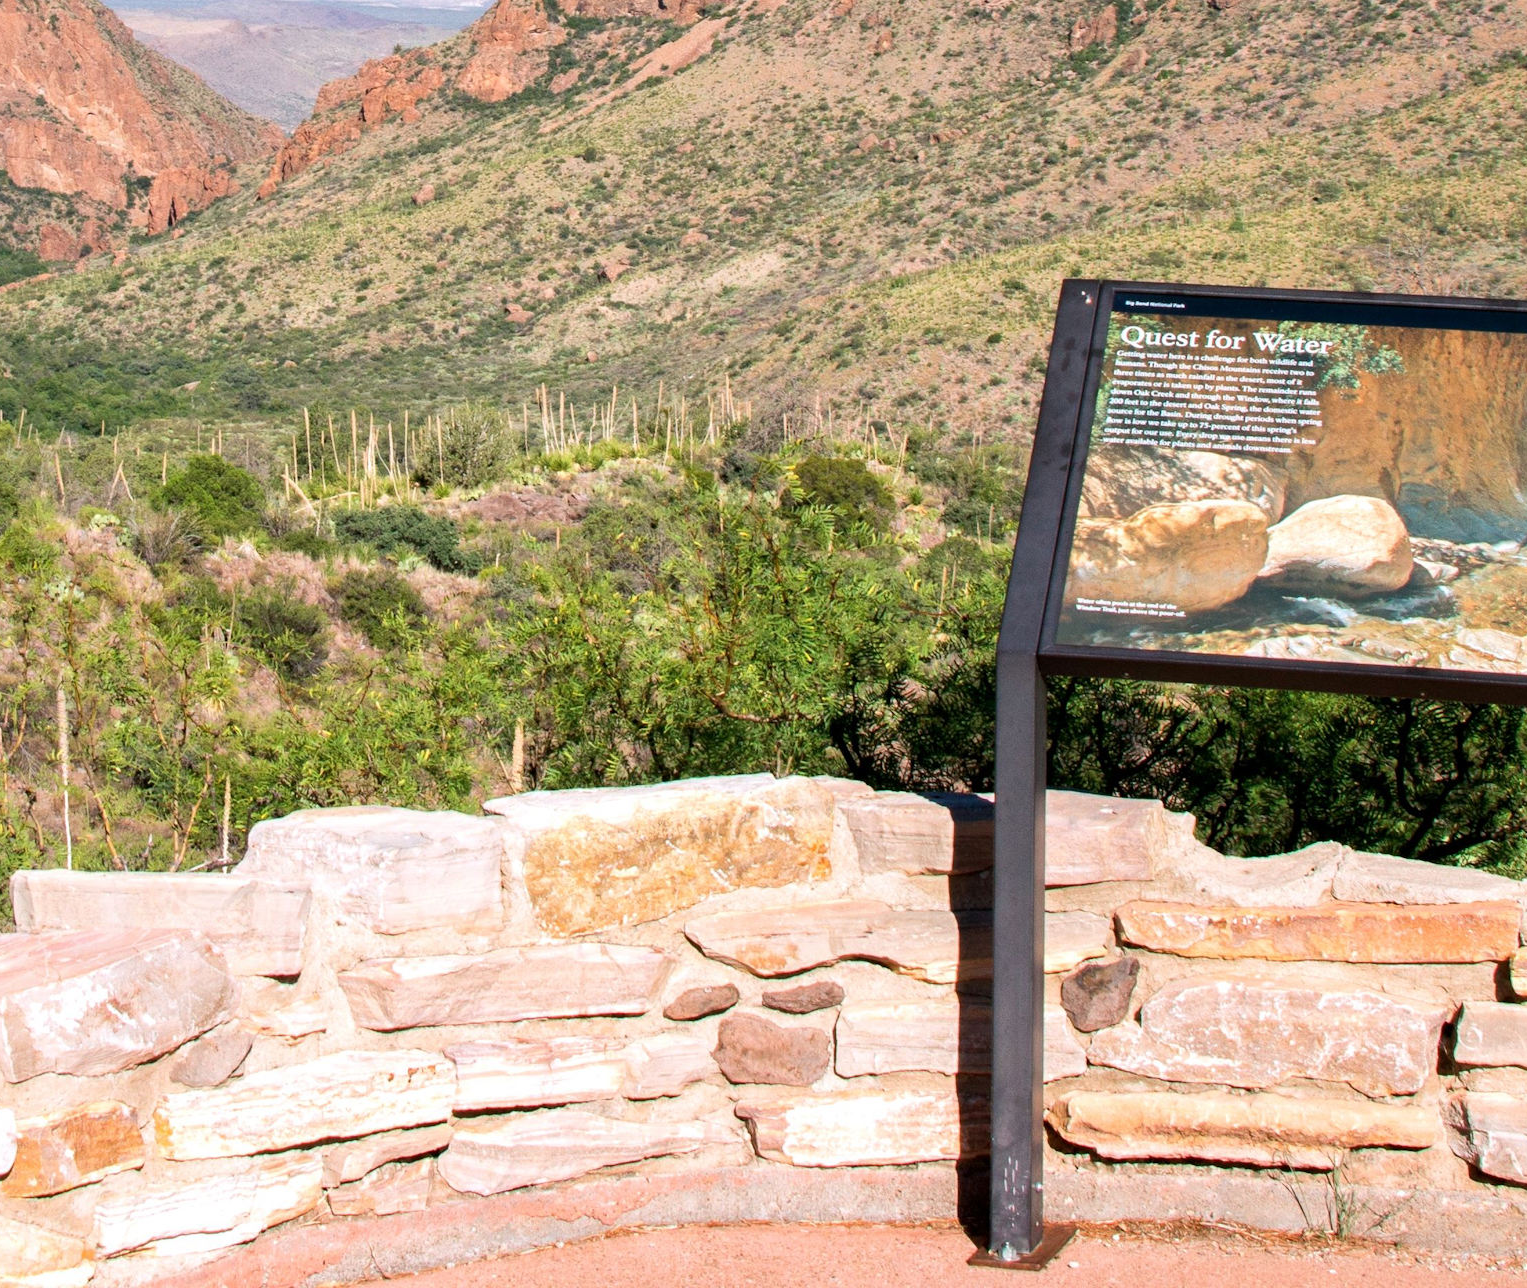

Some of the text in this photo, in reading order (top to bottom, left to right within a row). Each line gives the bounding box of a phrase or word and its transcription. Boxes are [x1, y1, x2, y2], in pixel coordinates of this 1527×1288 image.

[1121, 326, 1333, 354] Quest for Water
[1117, 351, 1145, 359] Getting
[1201, 355, 1235, 364] challenge
[1148, 362, 1178, 370] Though
[1112, 380, 1152, 388] evaporates
[1215, 384, 1239, 393] plants.
[1191, 393, 1221, 402] through
[1222, 405, 1248, 413] Spring,
[1185, 412, 1212, 420] During
[1214, 414, 1243, 422] drought
[1245, 416, 1274, 424] periods
[1298, 418, 1322, 426] spring
[1176, 431, 1196, 439] Every
[1200, 422, 1240, 431] 75-percent
[1267, 427, 1297, 435] spring's
[1172, 440, 1195, 448] plants
[1243, 445, 1292, 453] downstream.
